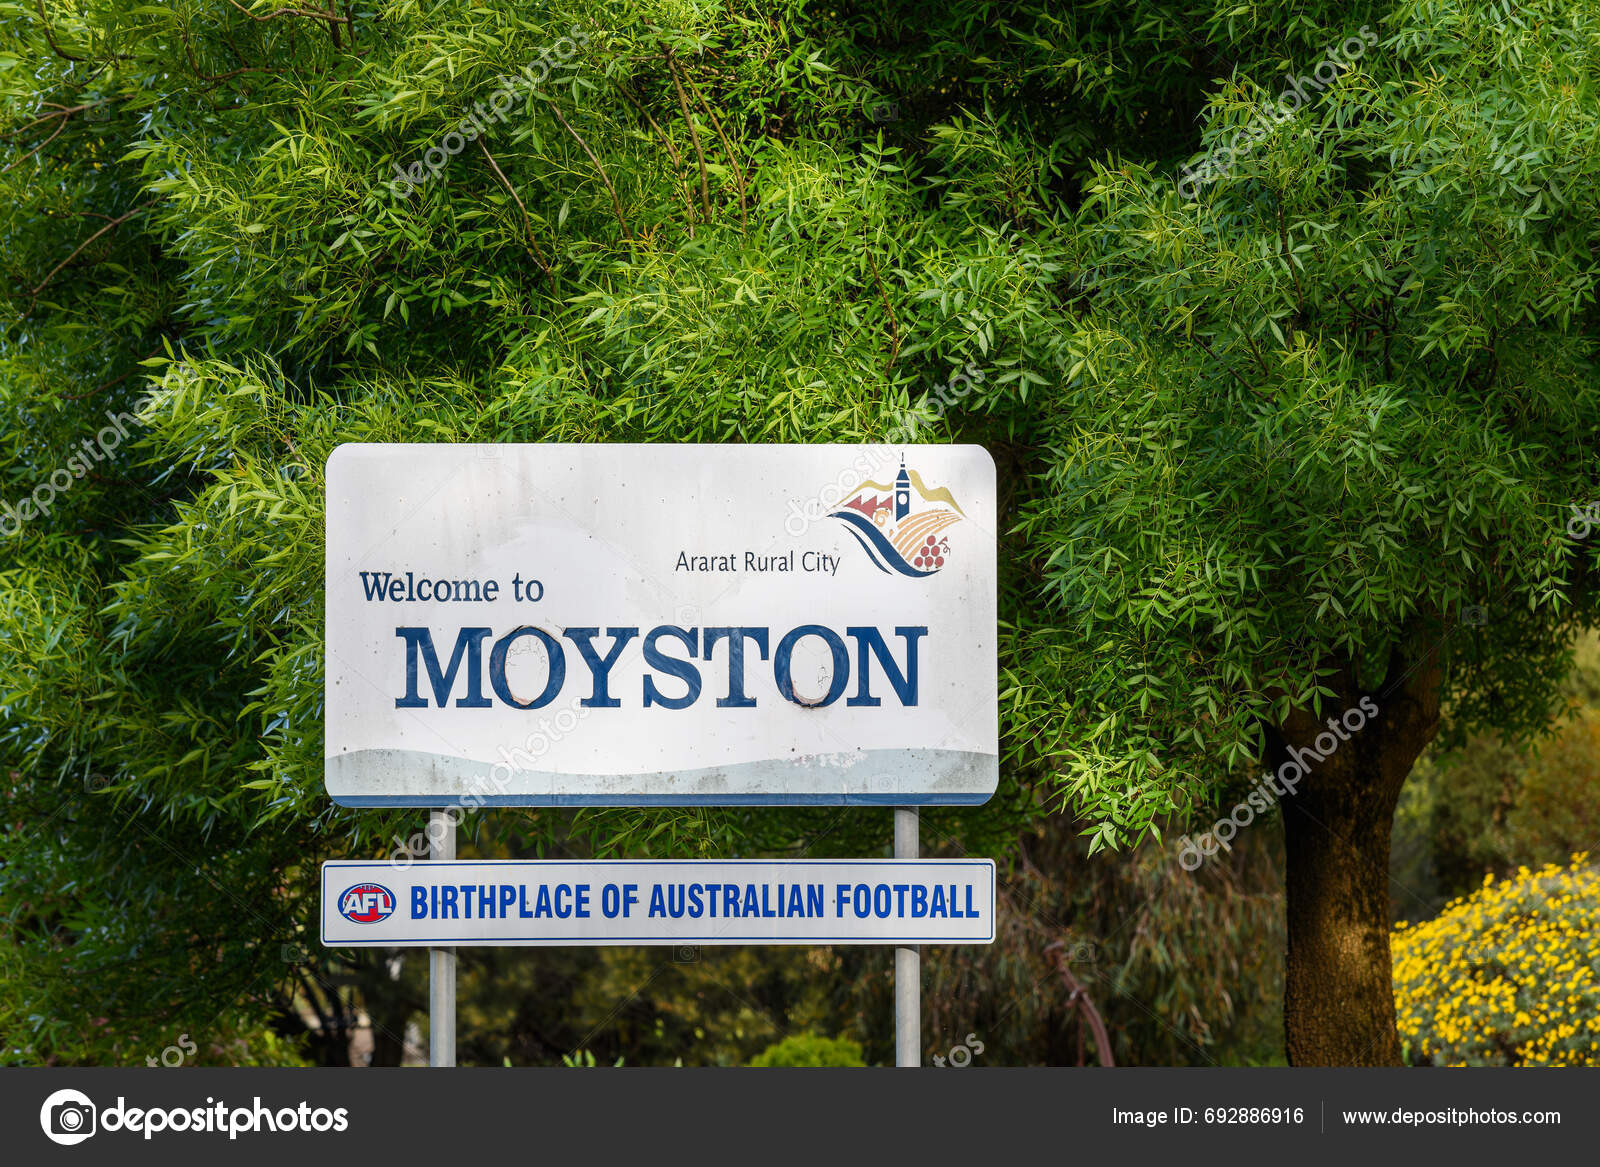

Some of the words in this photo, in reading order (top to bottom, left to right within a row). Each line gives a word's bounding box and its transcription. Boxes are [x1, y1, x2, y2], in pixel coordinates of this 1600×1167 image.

[675, 550, 737, 572] Ararat
[744, 550, 794, 572] Rural
[802, 551, 841, 577] City
[358, 571, 500, 603] Welcome
[511, 572, 544, 603] to
[395, 624, 929, 710] MOYSTON
[343, 892, 393, 916] AFL
[410, 884, 591, 920] BIRTHPLACE
[601, 883, 639, 919] OF
[648, 883, 825, 919] AUSTRALIAN
[836, 883, 980, 919] FOOTBALL
